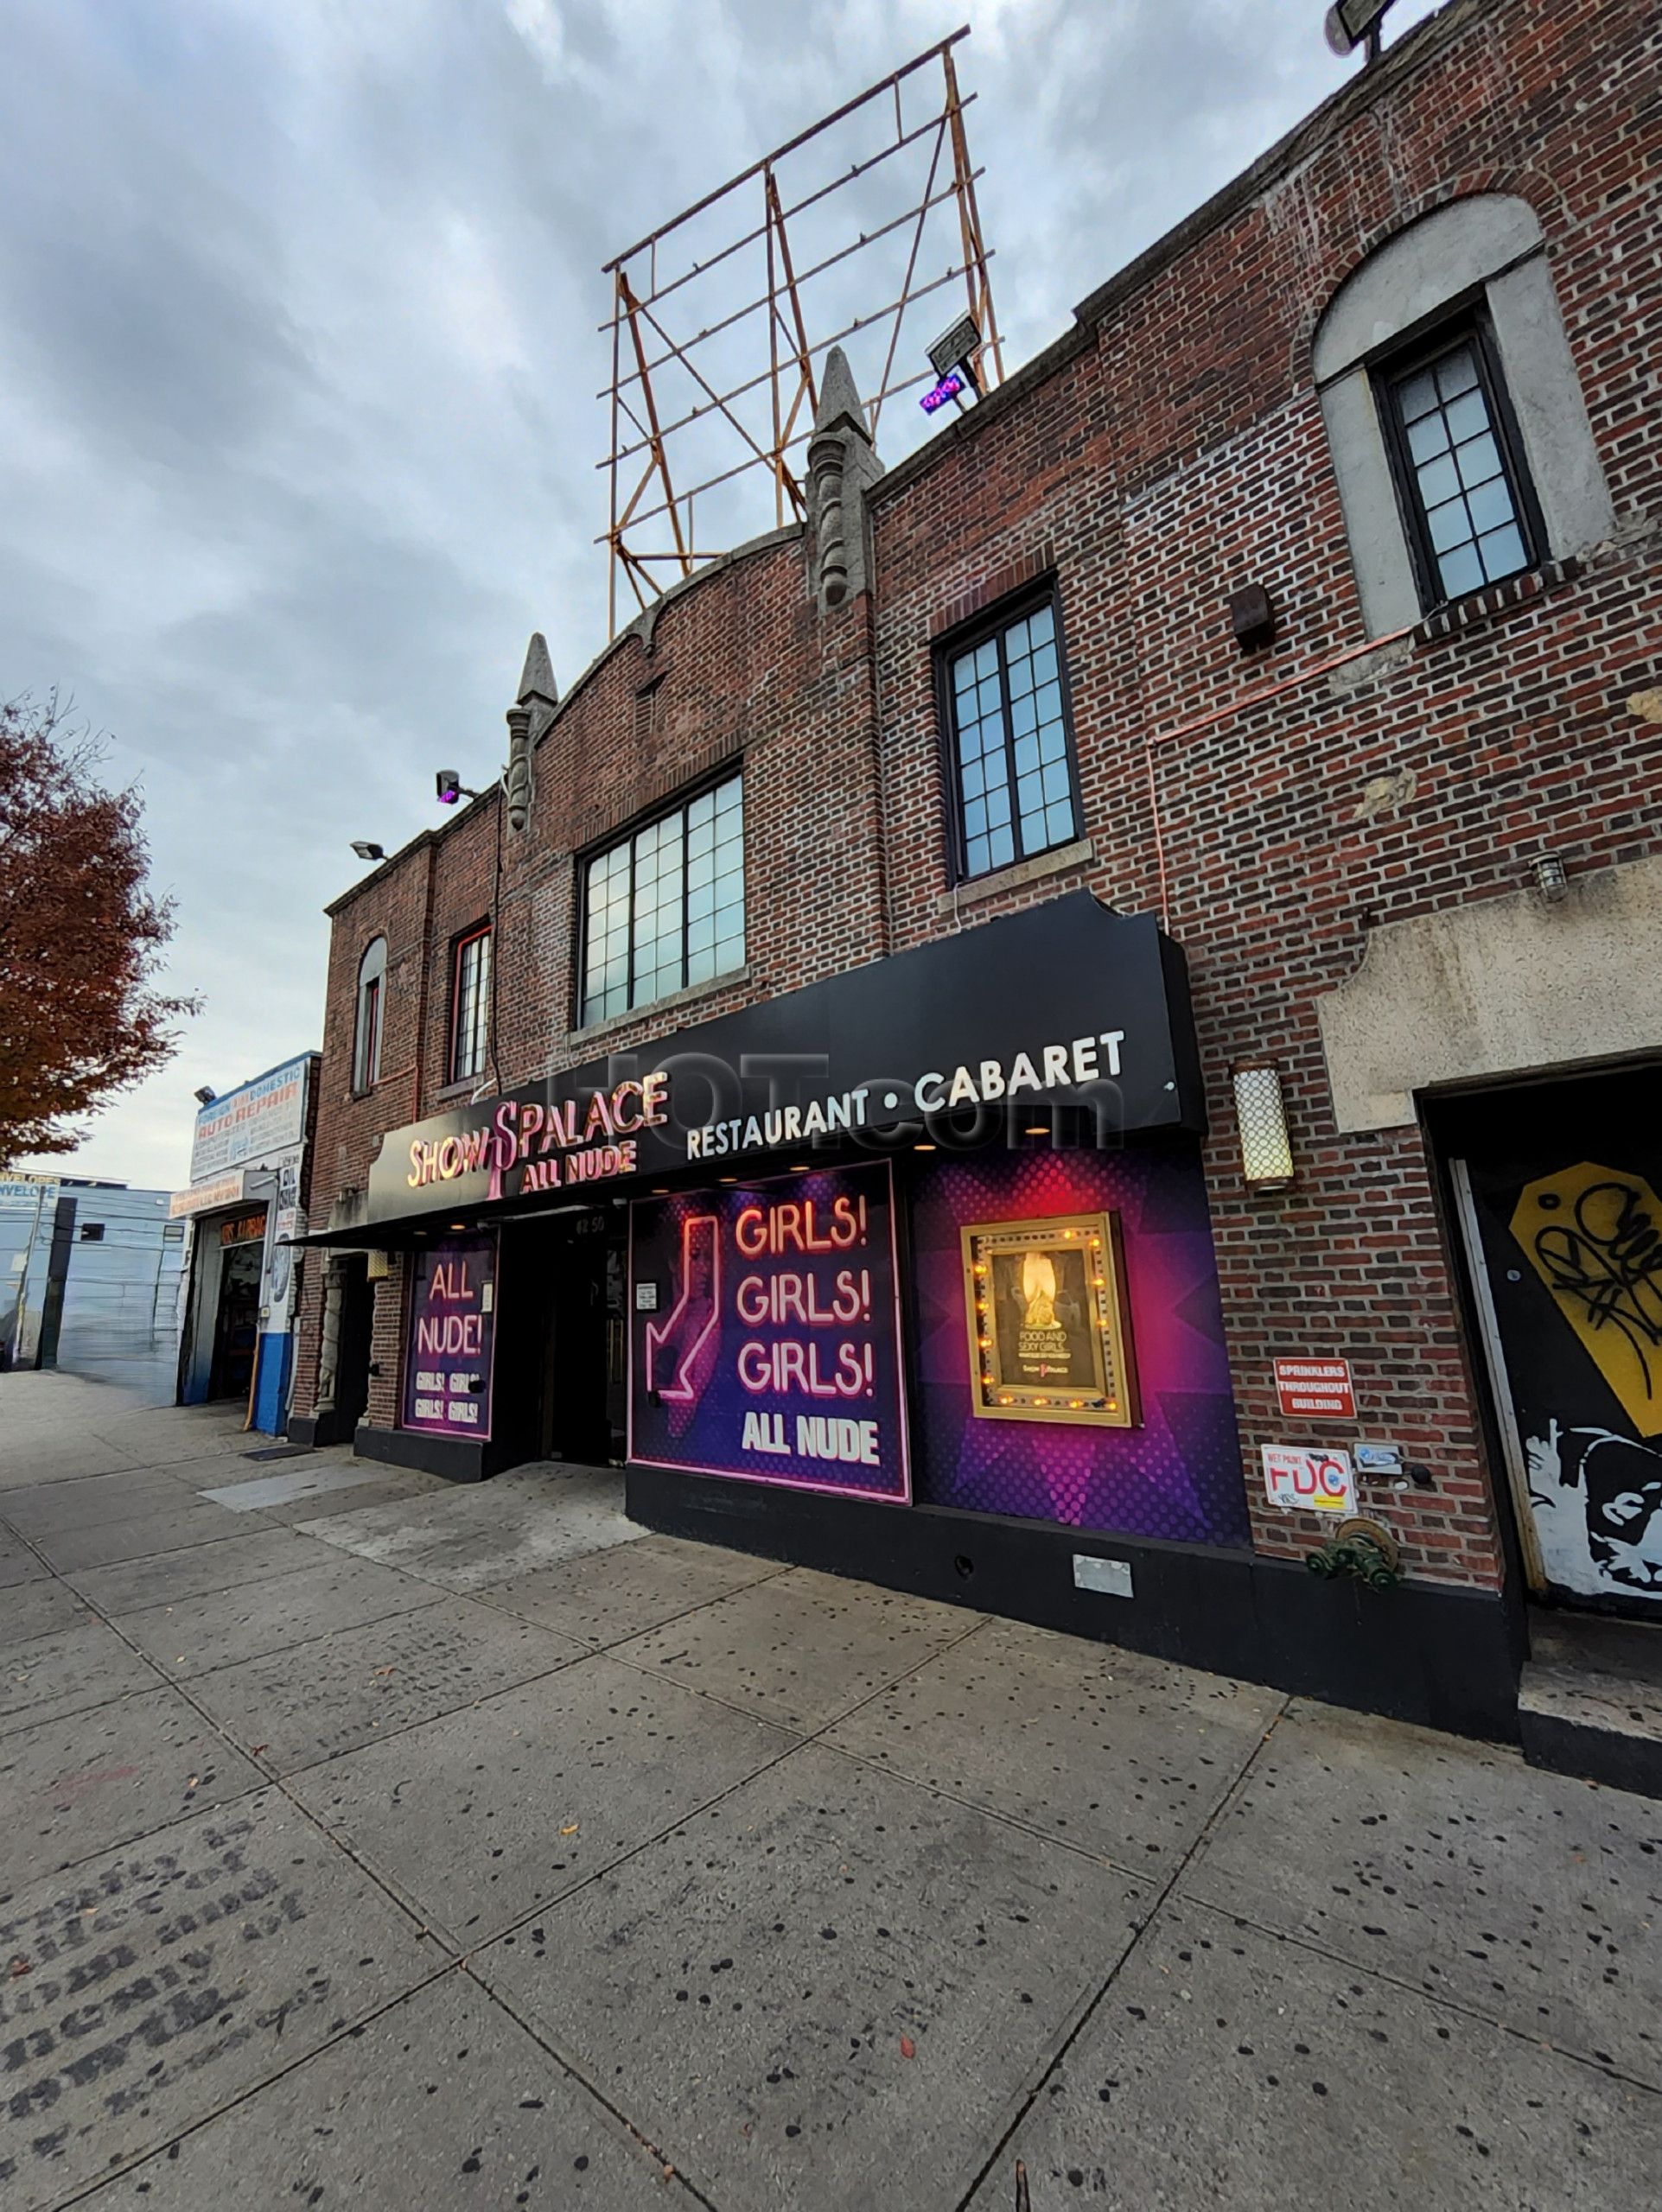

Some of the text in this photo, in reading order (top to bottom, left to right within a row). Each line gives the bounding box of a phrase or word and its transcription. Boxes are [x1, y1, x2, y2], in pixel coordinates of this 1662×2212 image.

[250, 1067, 300, 1102] DOMESTIC
[686, 1031, 1125, 1160] RESTAURANT CABARET
[198, 1115, 232, 1140] AUTO
[236, 1081, 298, 1122] REPAIR
[519, 1140, 637, 1195] ALL NUDE
[735, 1195, 867, 1255] GIRLS!
[430, 1261, 474, 1300] ALL
[736, 1269, 871, 1324] GIRLS!
[417, 1315, 482, 1354] NUDE!
[416, 1371, 444, 1392] GIRLS!
[737, 1342, 874, 1397] GIRLS!
[1279, 1364, 1345, 1377] SPRINKLERS
[1280, 1381, 1349, 1394] THROUGHOUT
[415, 1398, 478, 1423] GIRLS! GIRLS!
[1292, 1397, 1342, 1410] BUILDING
[742, 1411, 881, 1465] ALL NUDE
